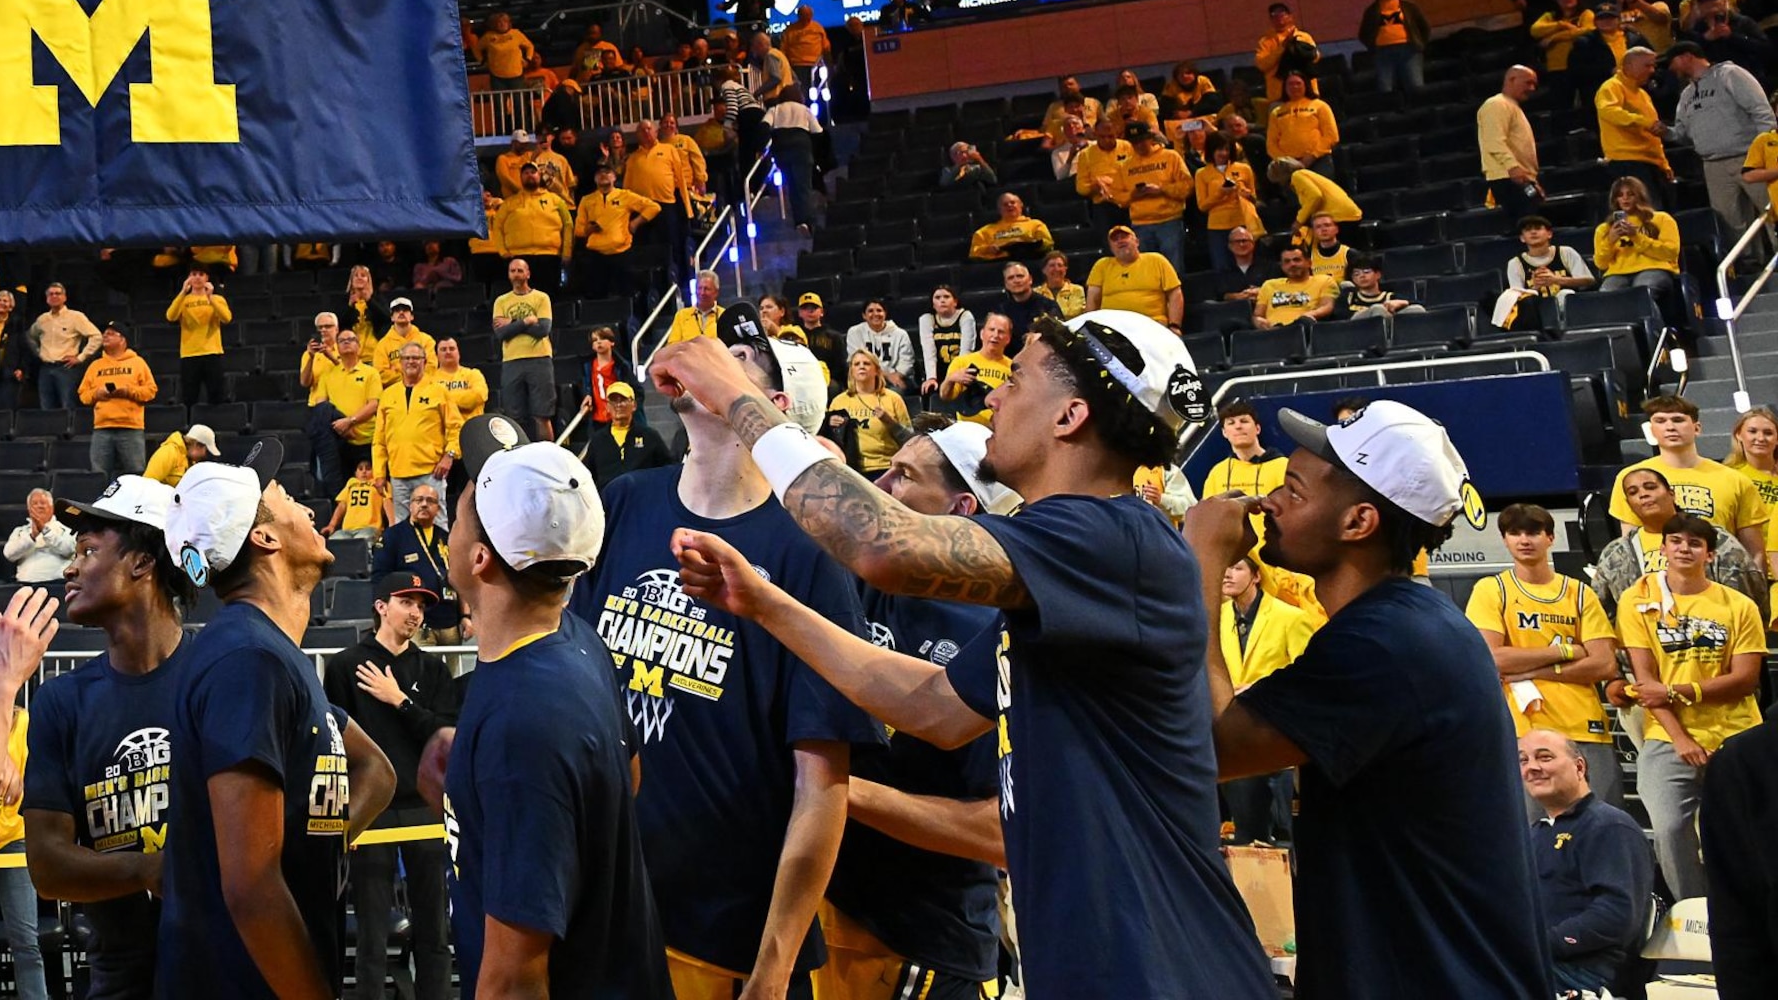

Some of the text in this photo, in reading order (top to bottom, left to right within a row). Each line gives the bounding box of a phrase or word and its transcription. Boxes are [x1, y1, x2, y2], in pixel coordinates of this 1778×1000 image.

[96, 366, 133, 377] MICHIGAN
[350, 490, 371, 507] 55
[623, 586, 638, 599] 20
[689, 606, 707, 620] 26
[641, 605, 735, 648] BASKETBALL
[597, 611, 734, 685] CHAMPIONS
[629, 659, 665, 699] M
[105, 764, 120, 778] 20
